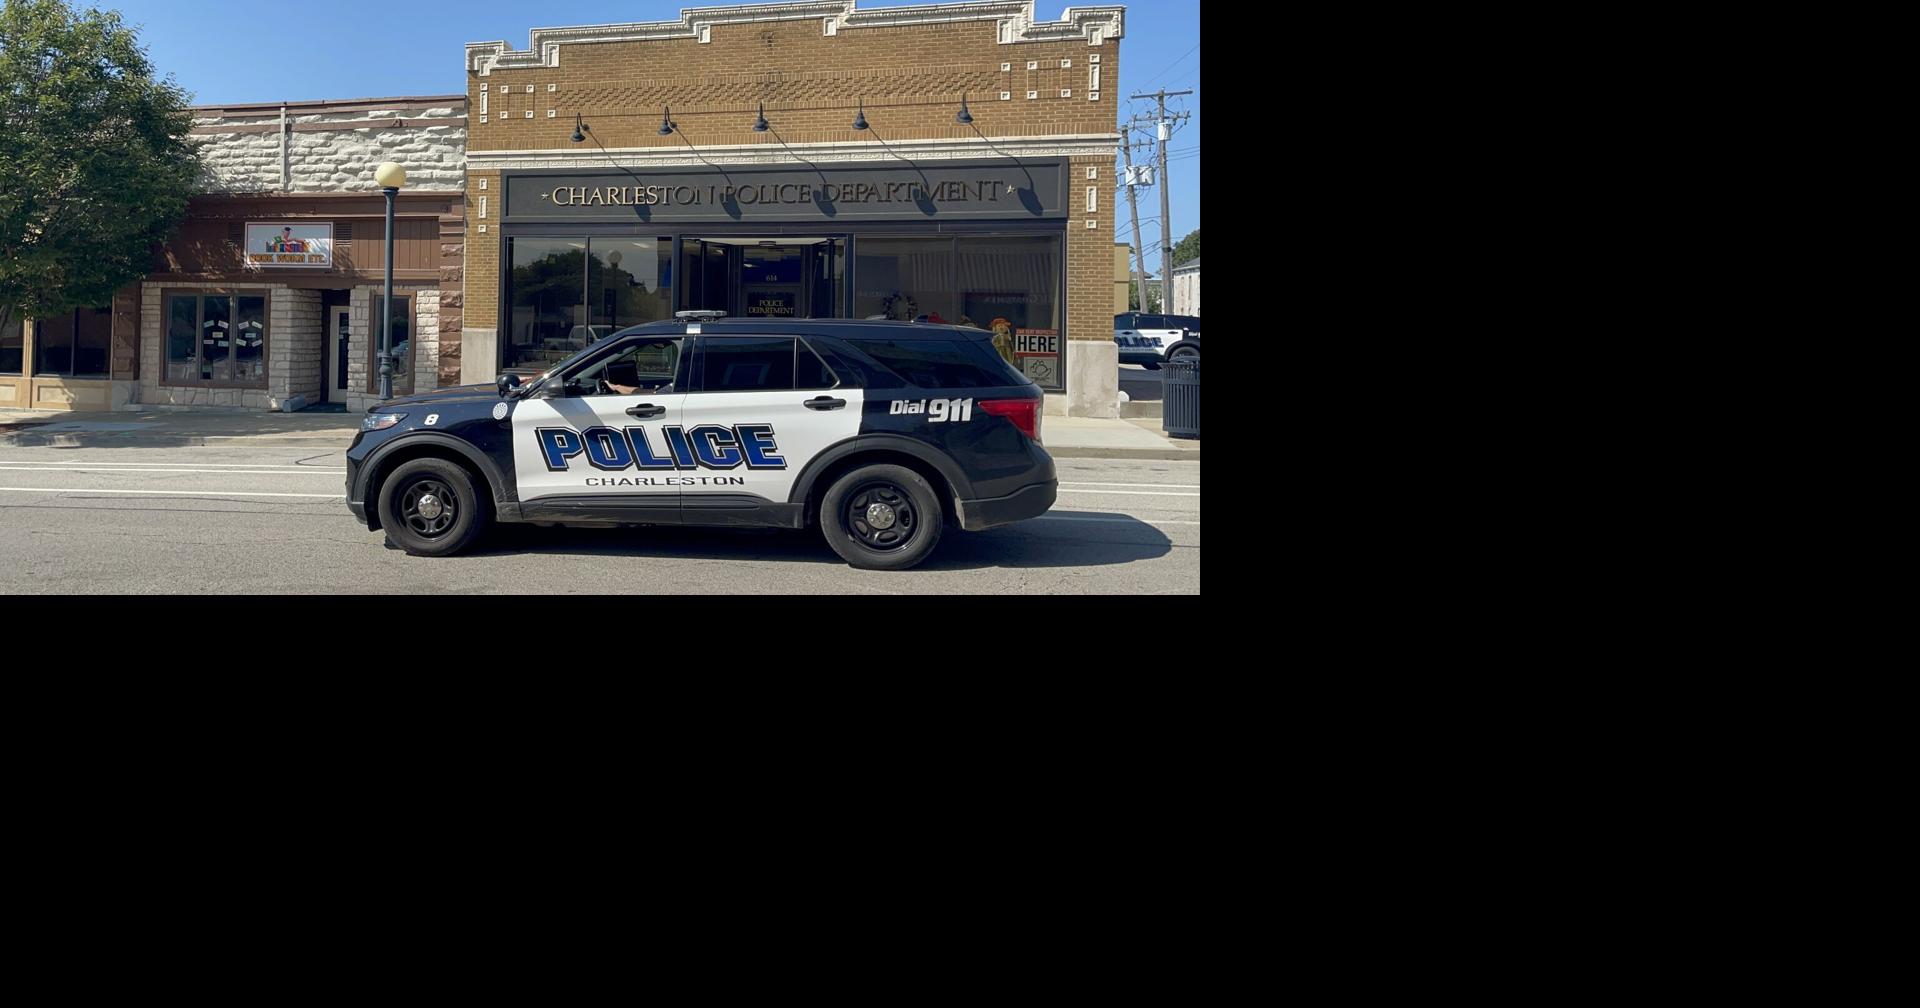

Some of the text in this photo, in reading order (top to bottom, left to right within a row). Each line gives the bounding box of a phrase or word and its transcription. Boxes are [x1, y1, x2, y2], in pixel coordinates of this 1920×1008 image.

[552, 180, 1004, 207] CHARLESTON POLICE DEPARTMENT
[748, 306, 794, 314] DEPARTMENT
[759, 299, 784, 307] POLICE
[1017, 335, 1057, 352] HERE
[889, 398, 973, 423] Dial 911
[424, 414, 440, 426] 8
[535, 424, 787, 471] POLICE
[585, 476, 745, 487] CHARLESTON
